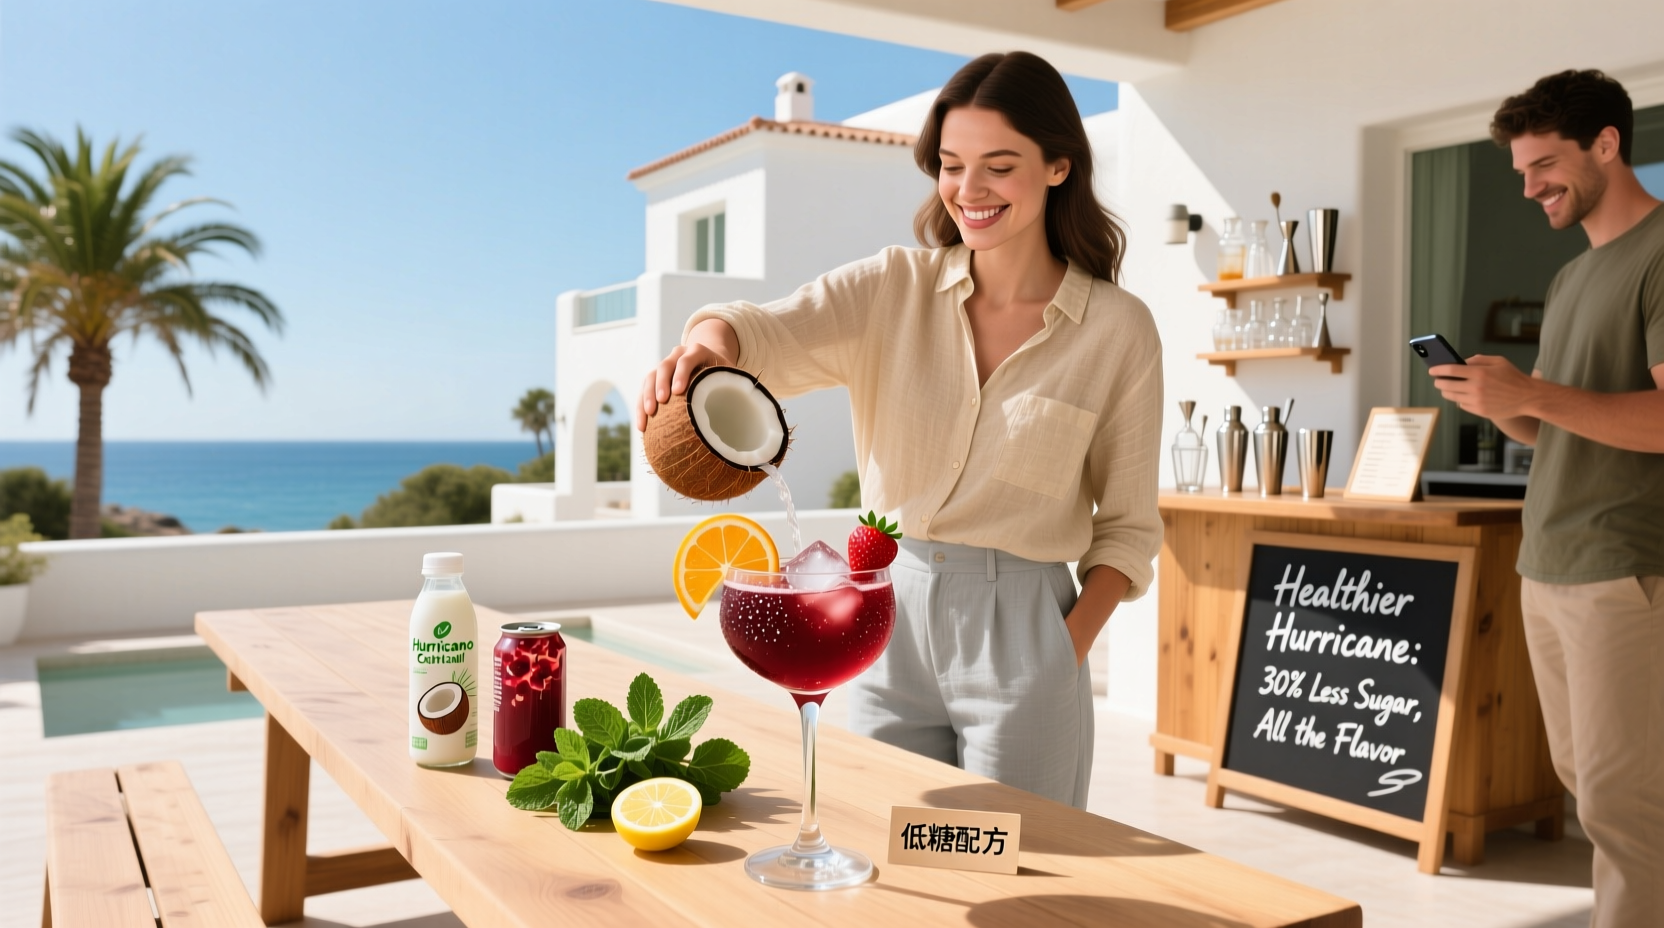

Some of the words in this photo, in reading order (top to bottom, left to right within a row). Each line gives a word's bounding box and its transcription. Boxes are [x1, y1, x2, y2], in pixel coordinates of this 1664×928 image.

[1274, 563, 1414, 617] Healthier
[1265, 611, 1422, 665] Hurricane:
[1258, 665, 1307, 698] 30%
[1308, 672, 1350, 705] Less
[1353, 678, 1422, 727] Sugar,
[1253, 707, 1293, 742] All
[1294, 715, 1326, 749] the
[1333, 722, 1406, 765] Flavor
[901, 822, 1008, 856] 低糖配方
